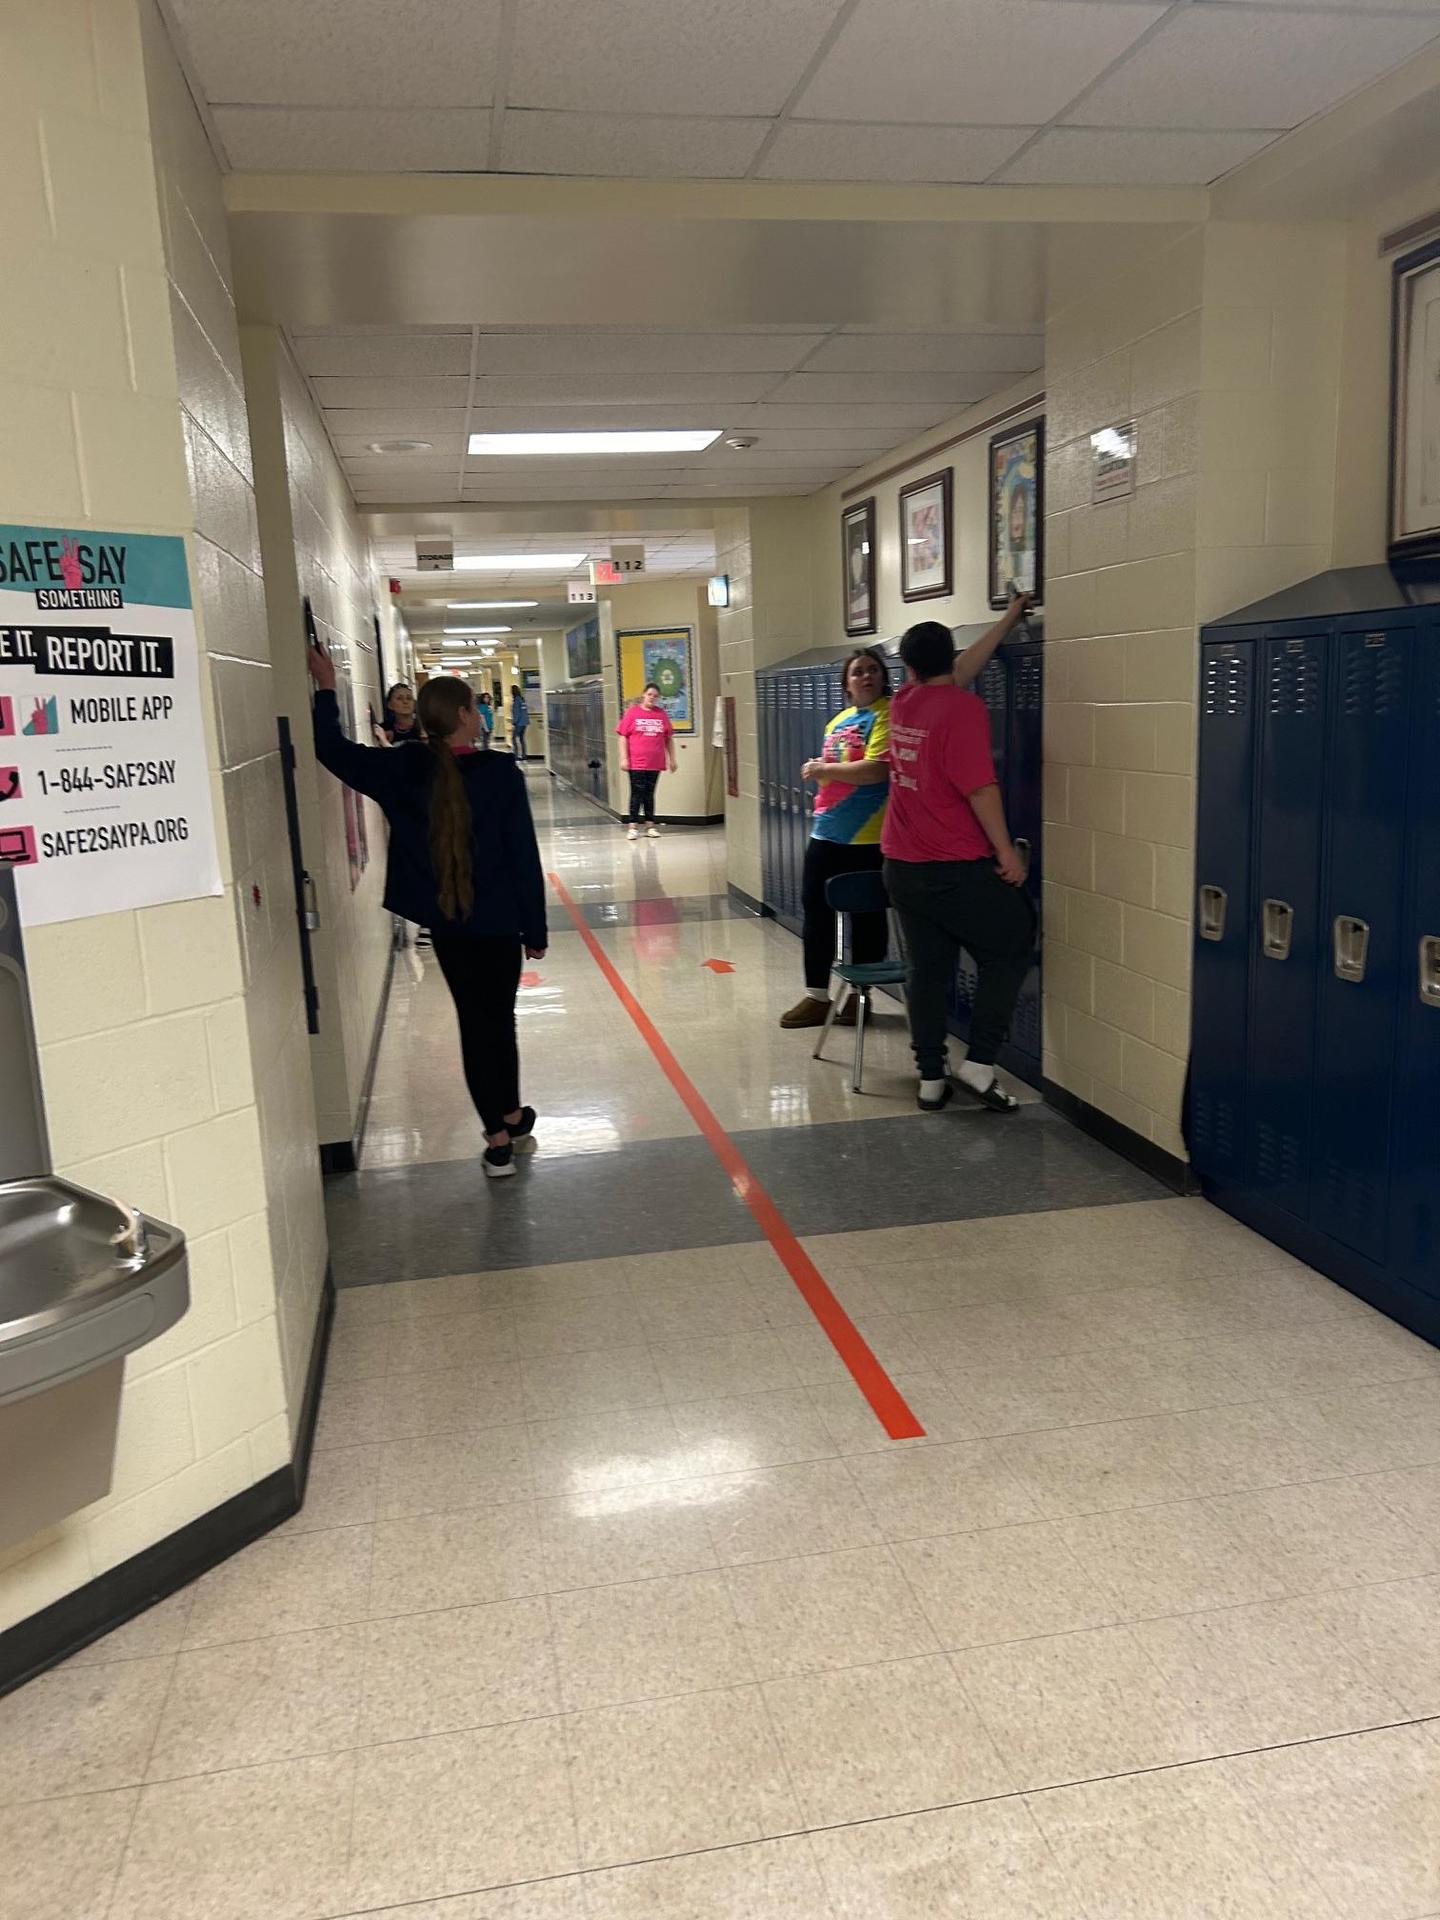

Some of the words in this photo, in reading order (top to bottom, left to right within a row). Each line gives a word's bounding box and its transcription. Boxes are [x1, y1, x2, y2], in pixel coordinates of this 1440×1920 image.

[78, 545, 126, 585] SAY
[613, 560, 643, 571] 112
[39, 589, 120, 608] SOMETHING
[571, 592, 594, 601] 113
[15, 630, 38, 658] IT.
[46, 635, 134, 672] REPORT
[139, 641, 162, 673] IT.
[70, 697, 137, 725] MOBILE
[142, 695, 173, 721] APP
[37, 759, 176, 796] 1-844-SAF2SAY
[41, 817, 189, 858] SAFE2SAYPA.ORG
